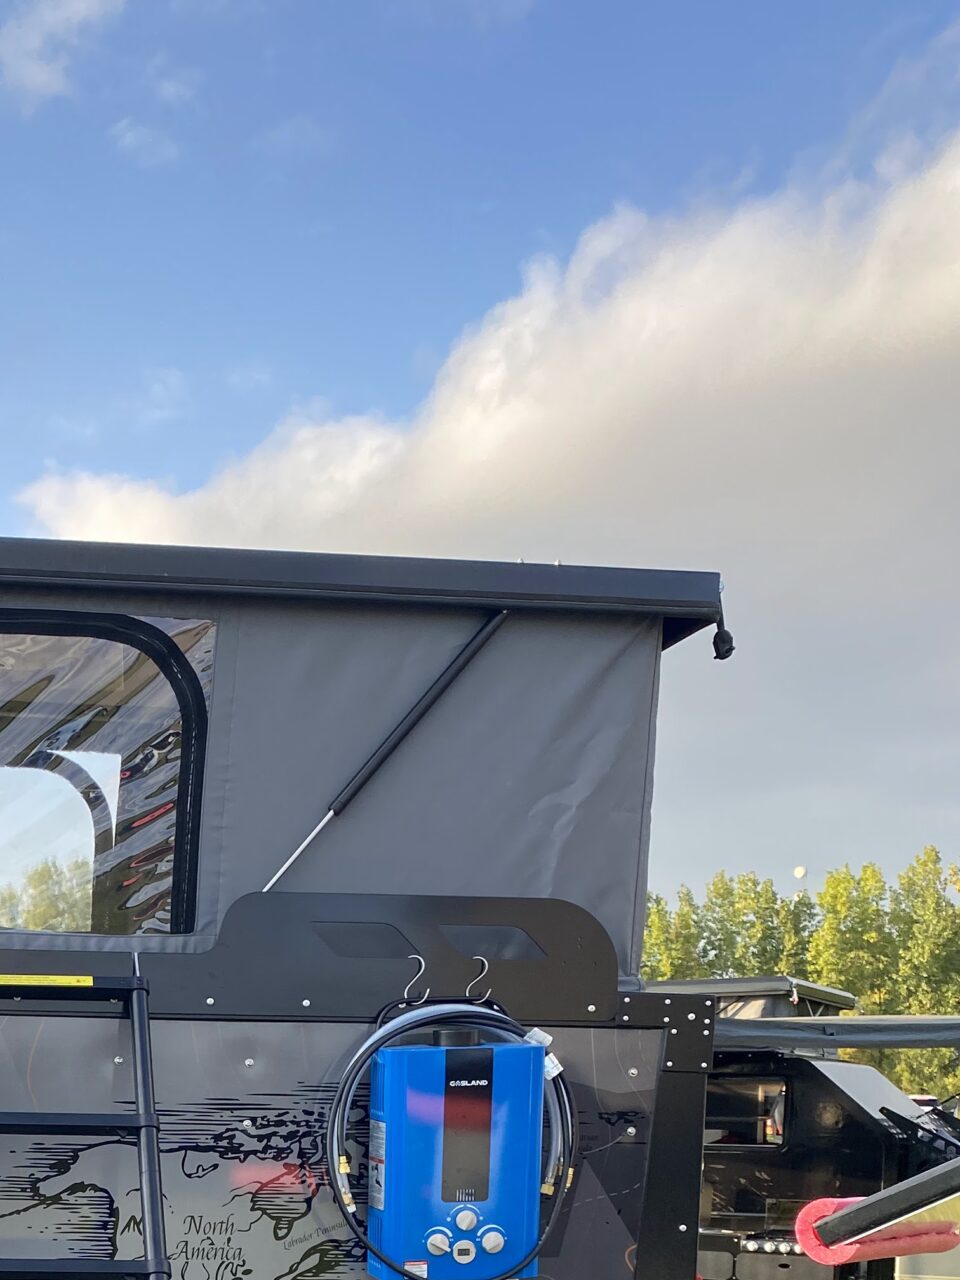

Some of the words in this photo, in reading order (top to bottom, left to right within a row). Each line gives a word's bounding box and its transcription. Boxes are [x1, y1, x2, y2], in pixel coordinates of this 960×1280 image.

[449, 1079, 489, 1087] GASLAND
[183, 1213, 235, 1235] North
[172, 1240, 245, 1261] America
